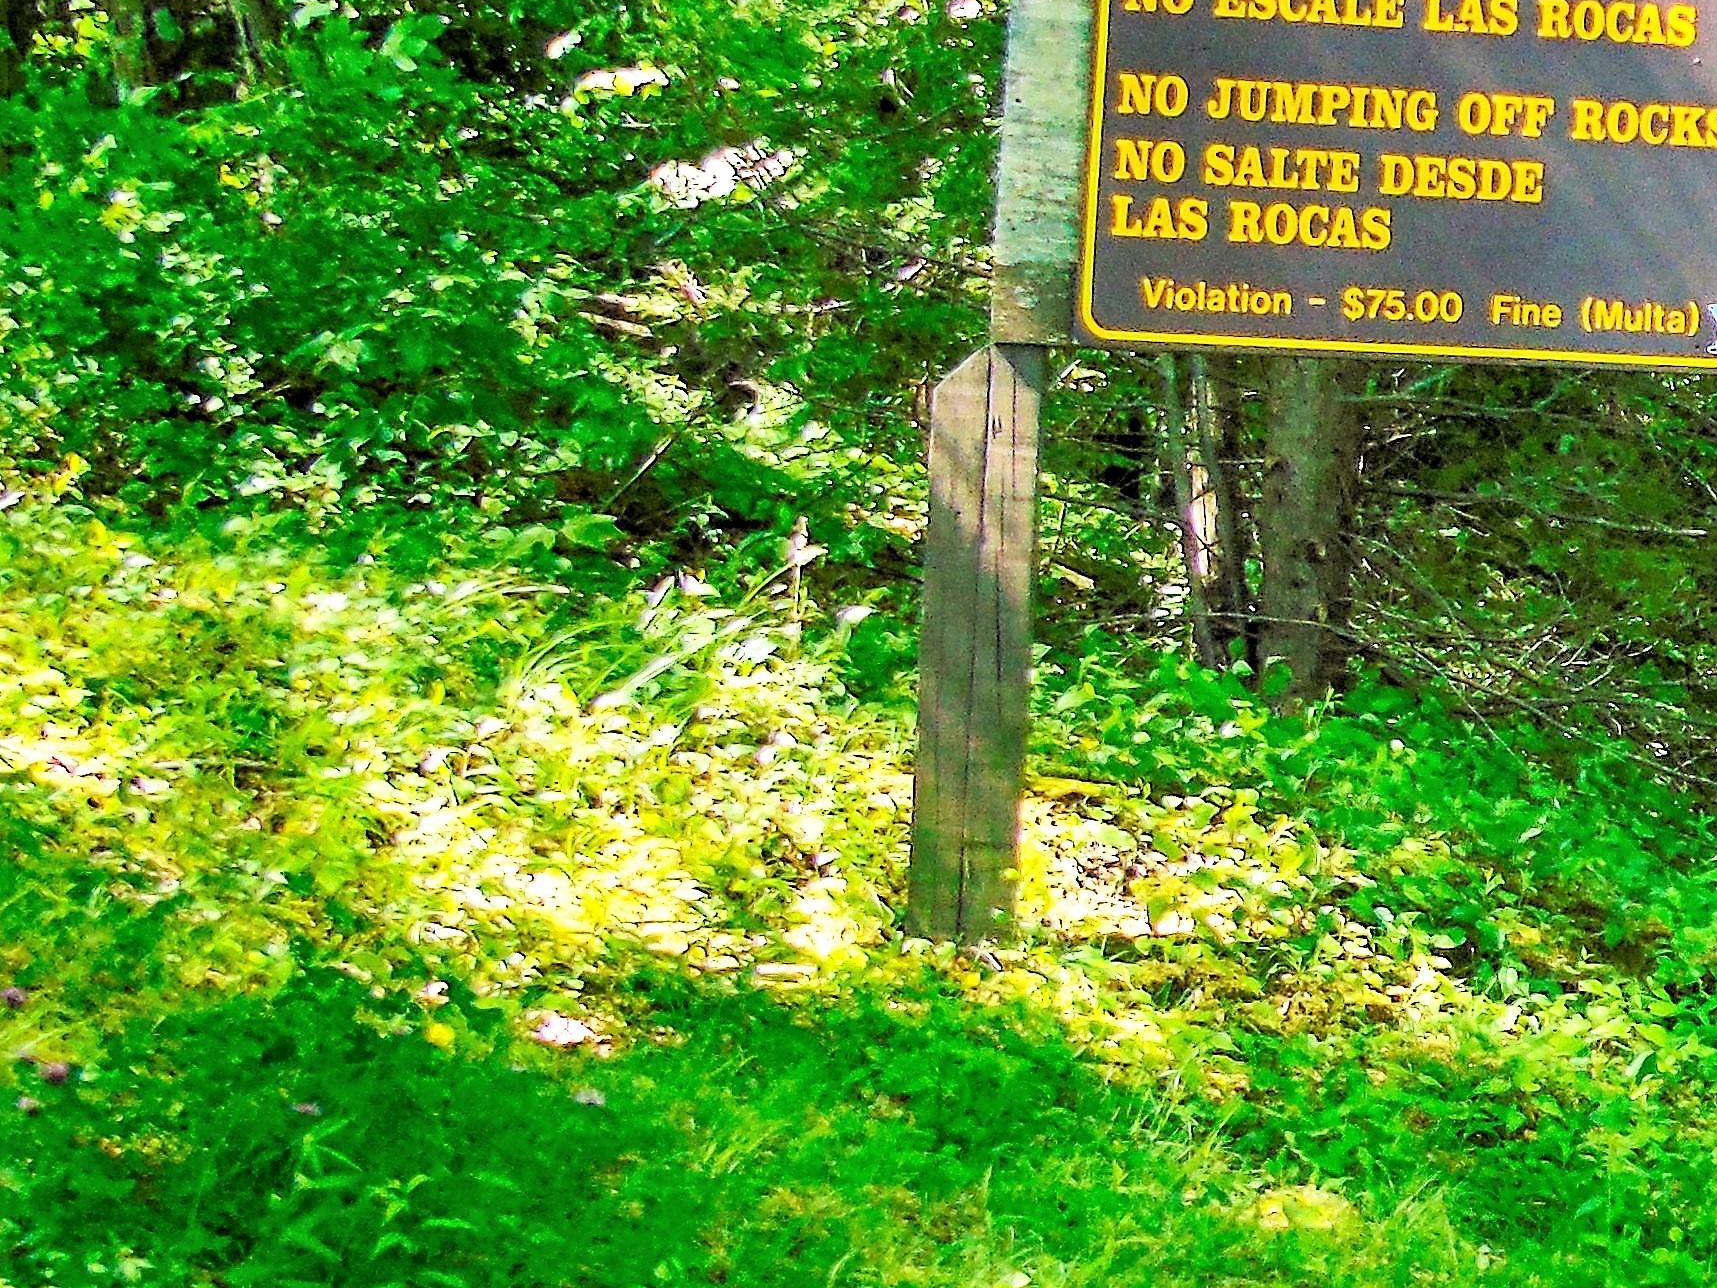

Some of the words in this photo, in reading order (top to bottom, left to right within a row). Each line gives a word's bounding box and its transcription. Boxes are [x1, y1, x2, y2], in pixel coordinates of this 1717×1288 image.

[1117, 73, 1190, 117] NO
[1206, 77, 1440, 133] JUMPING
[1457, 92, 1554, 140] OFF
[1113, 139, 1185, 183] NO
[1203, 144, 1361, 194] SALTE
[1379, 153, 1545, 203] DESDE
[1109, 195, 1208, 241] LAS
[1227, 201, 1392, 250] ROCAS
[1140, 276, 1293, 315] Violation
[1343, 288, 1463, 325] $75.00
[1490, 294, 1561, 328] Fine
[1580, 296, 1700, 338] (Multa)
